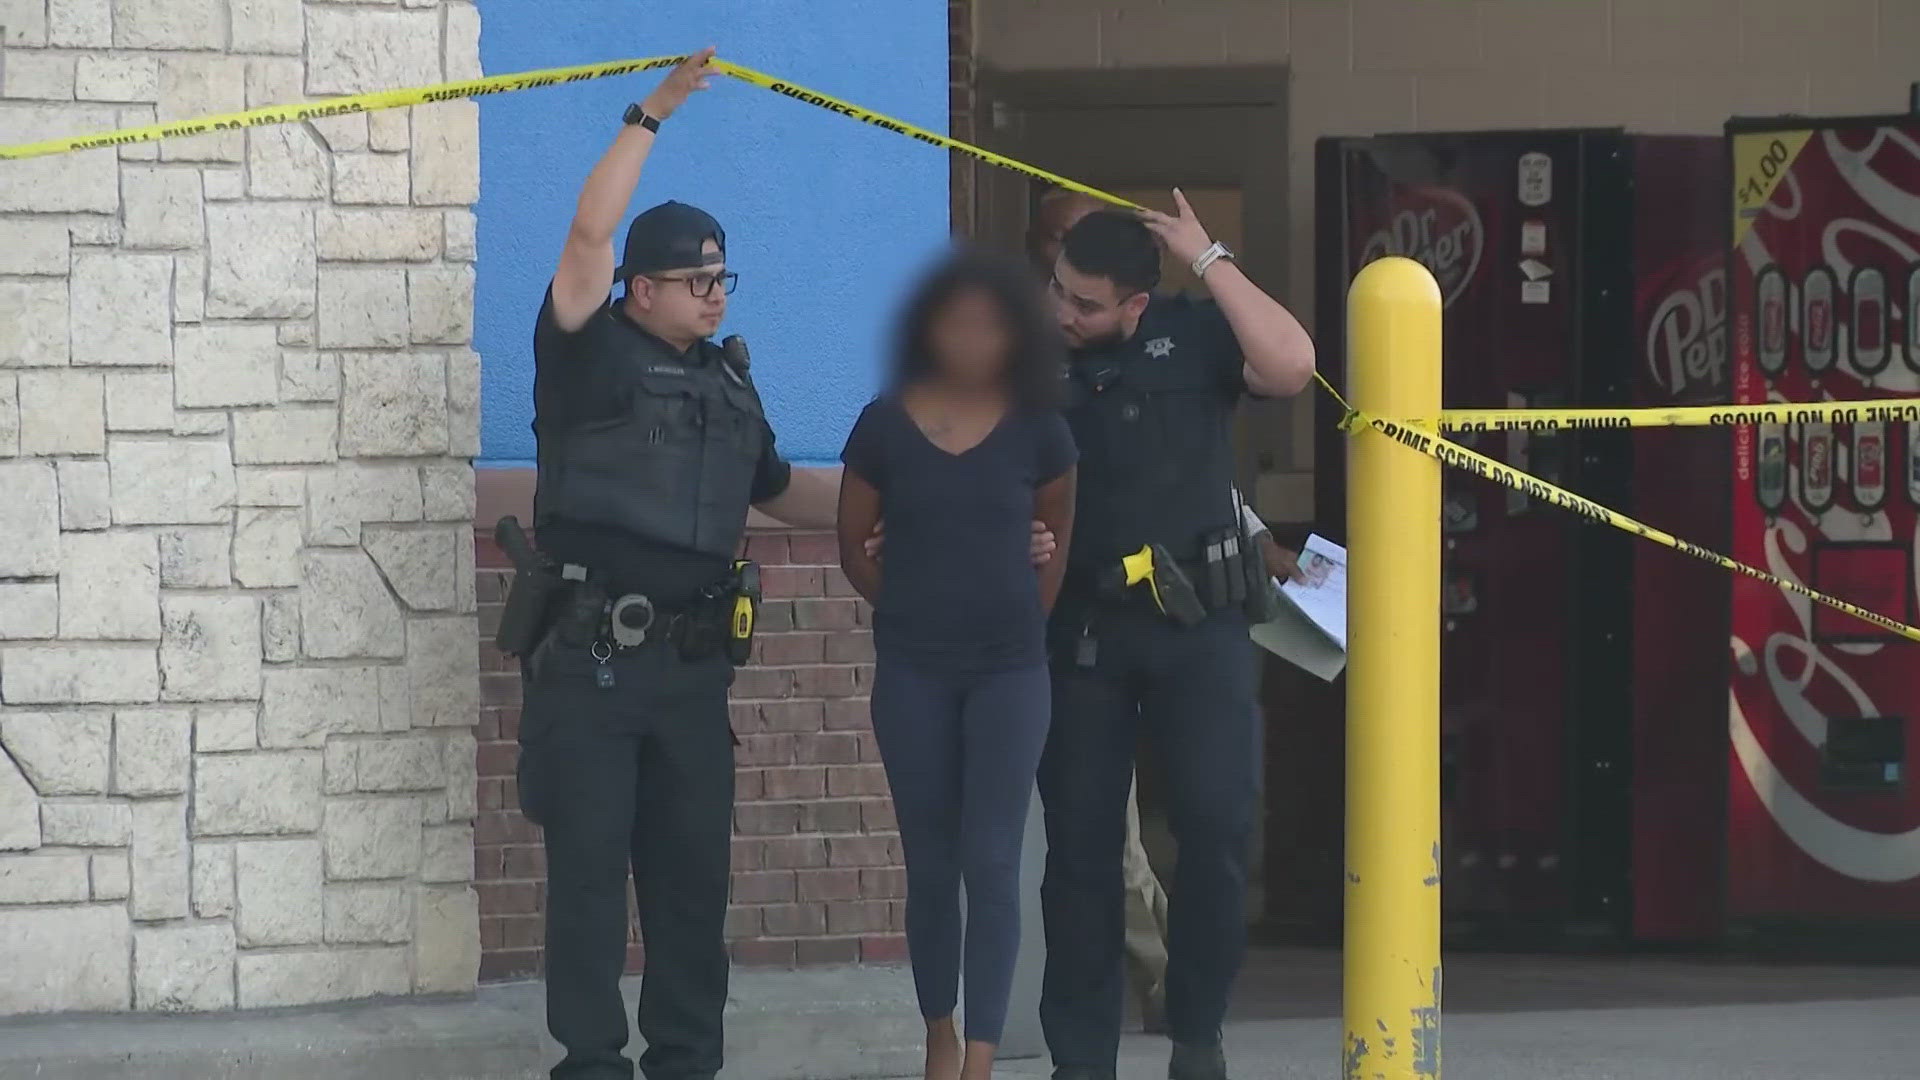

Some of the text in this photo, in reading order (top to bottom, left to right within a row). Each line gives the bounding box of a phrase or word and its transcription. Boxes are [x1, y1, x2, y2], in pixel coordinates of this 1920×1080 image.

[1738, 139, 1788, 204] $1.00
[1866, 405, 1920, 422] CENE
[1371, 418, 1611, 524] CRIME SCENE DO NOT CROSS
